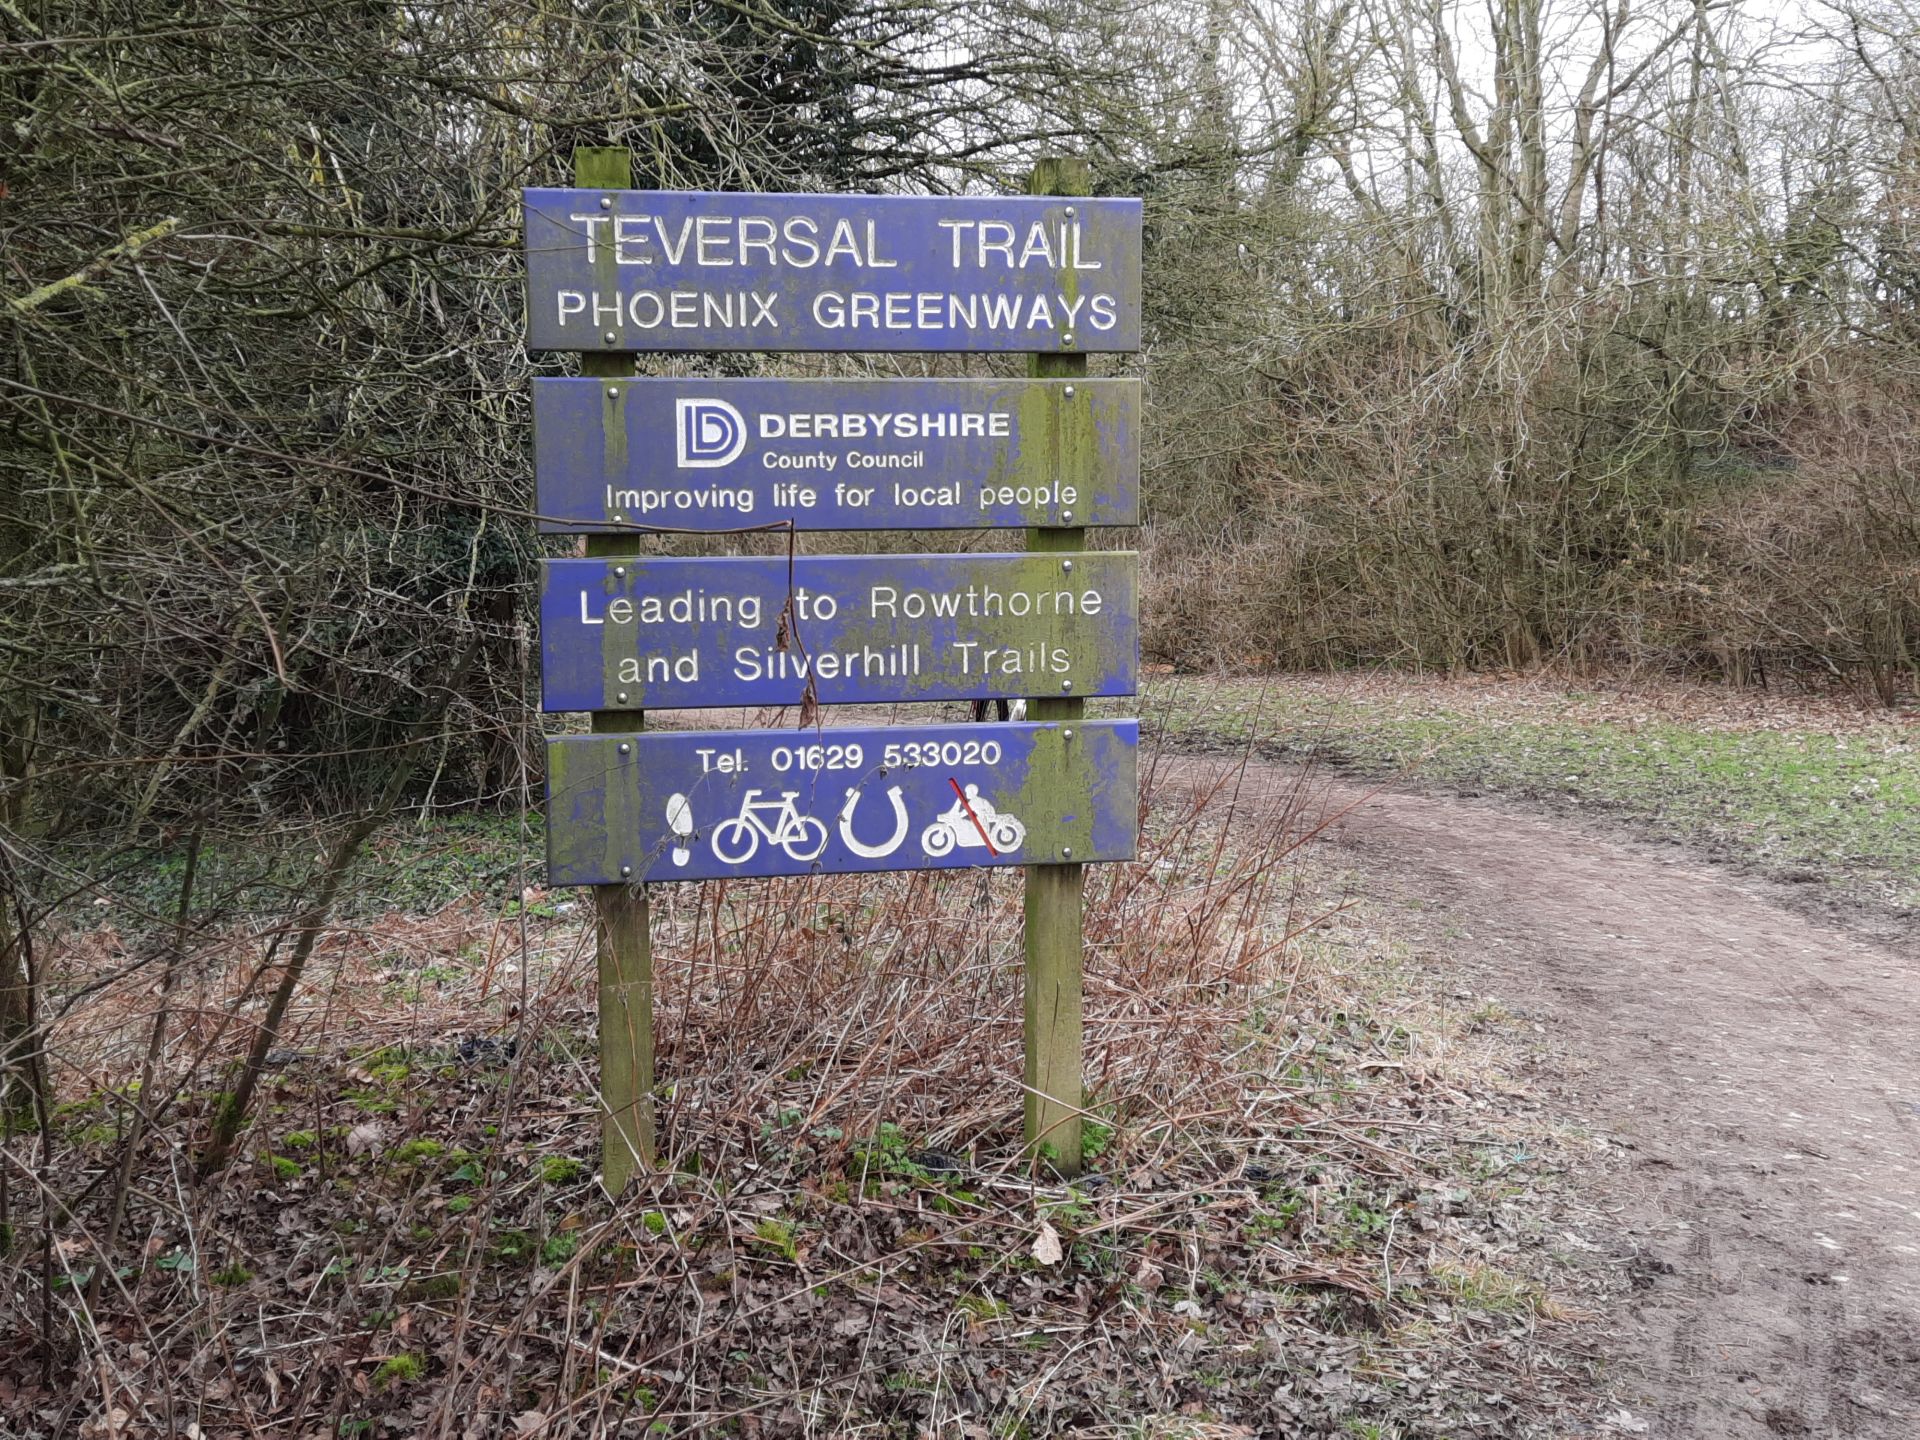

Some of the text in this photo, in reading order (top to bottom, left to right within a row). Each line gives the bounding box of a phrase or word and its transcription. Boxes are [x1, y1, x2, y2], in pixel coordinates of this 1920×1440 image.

[570, 212, 1102, 270] TEVERSAL TRAIL
[557, 290, 1118, 331] PHOENIX GREENWAYS
[759, 412, 1012, 439] DERBYSHIRE
[762, 450, 924, 472] County Council
[606, 481, 1078, 514] Improving life for local people
[580, 584, 1103, 629] Leading to Rowthorne
[618, 640, 1071, 684] and Silverhill Trails
[695, 740, 1002, 774] Tel. 01629 533020
